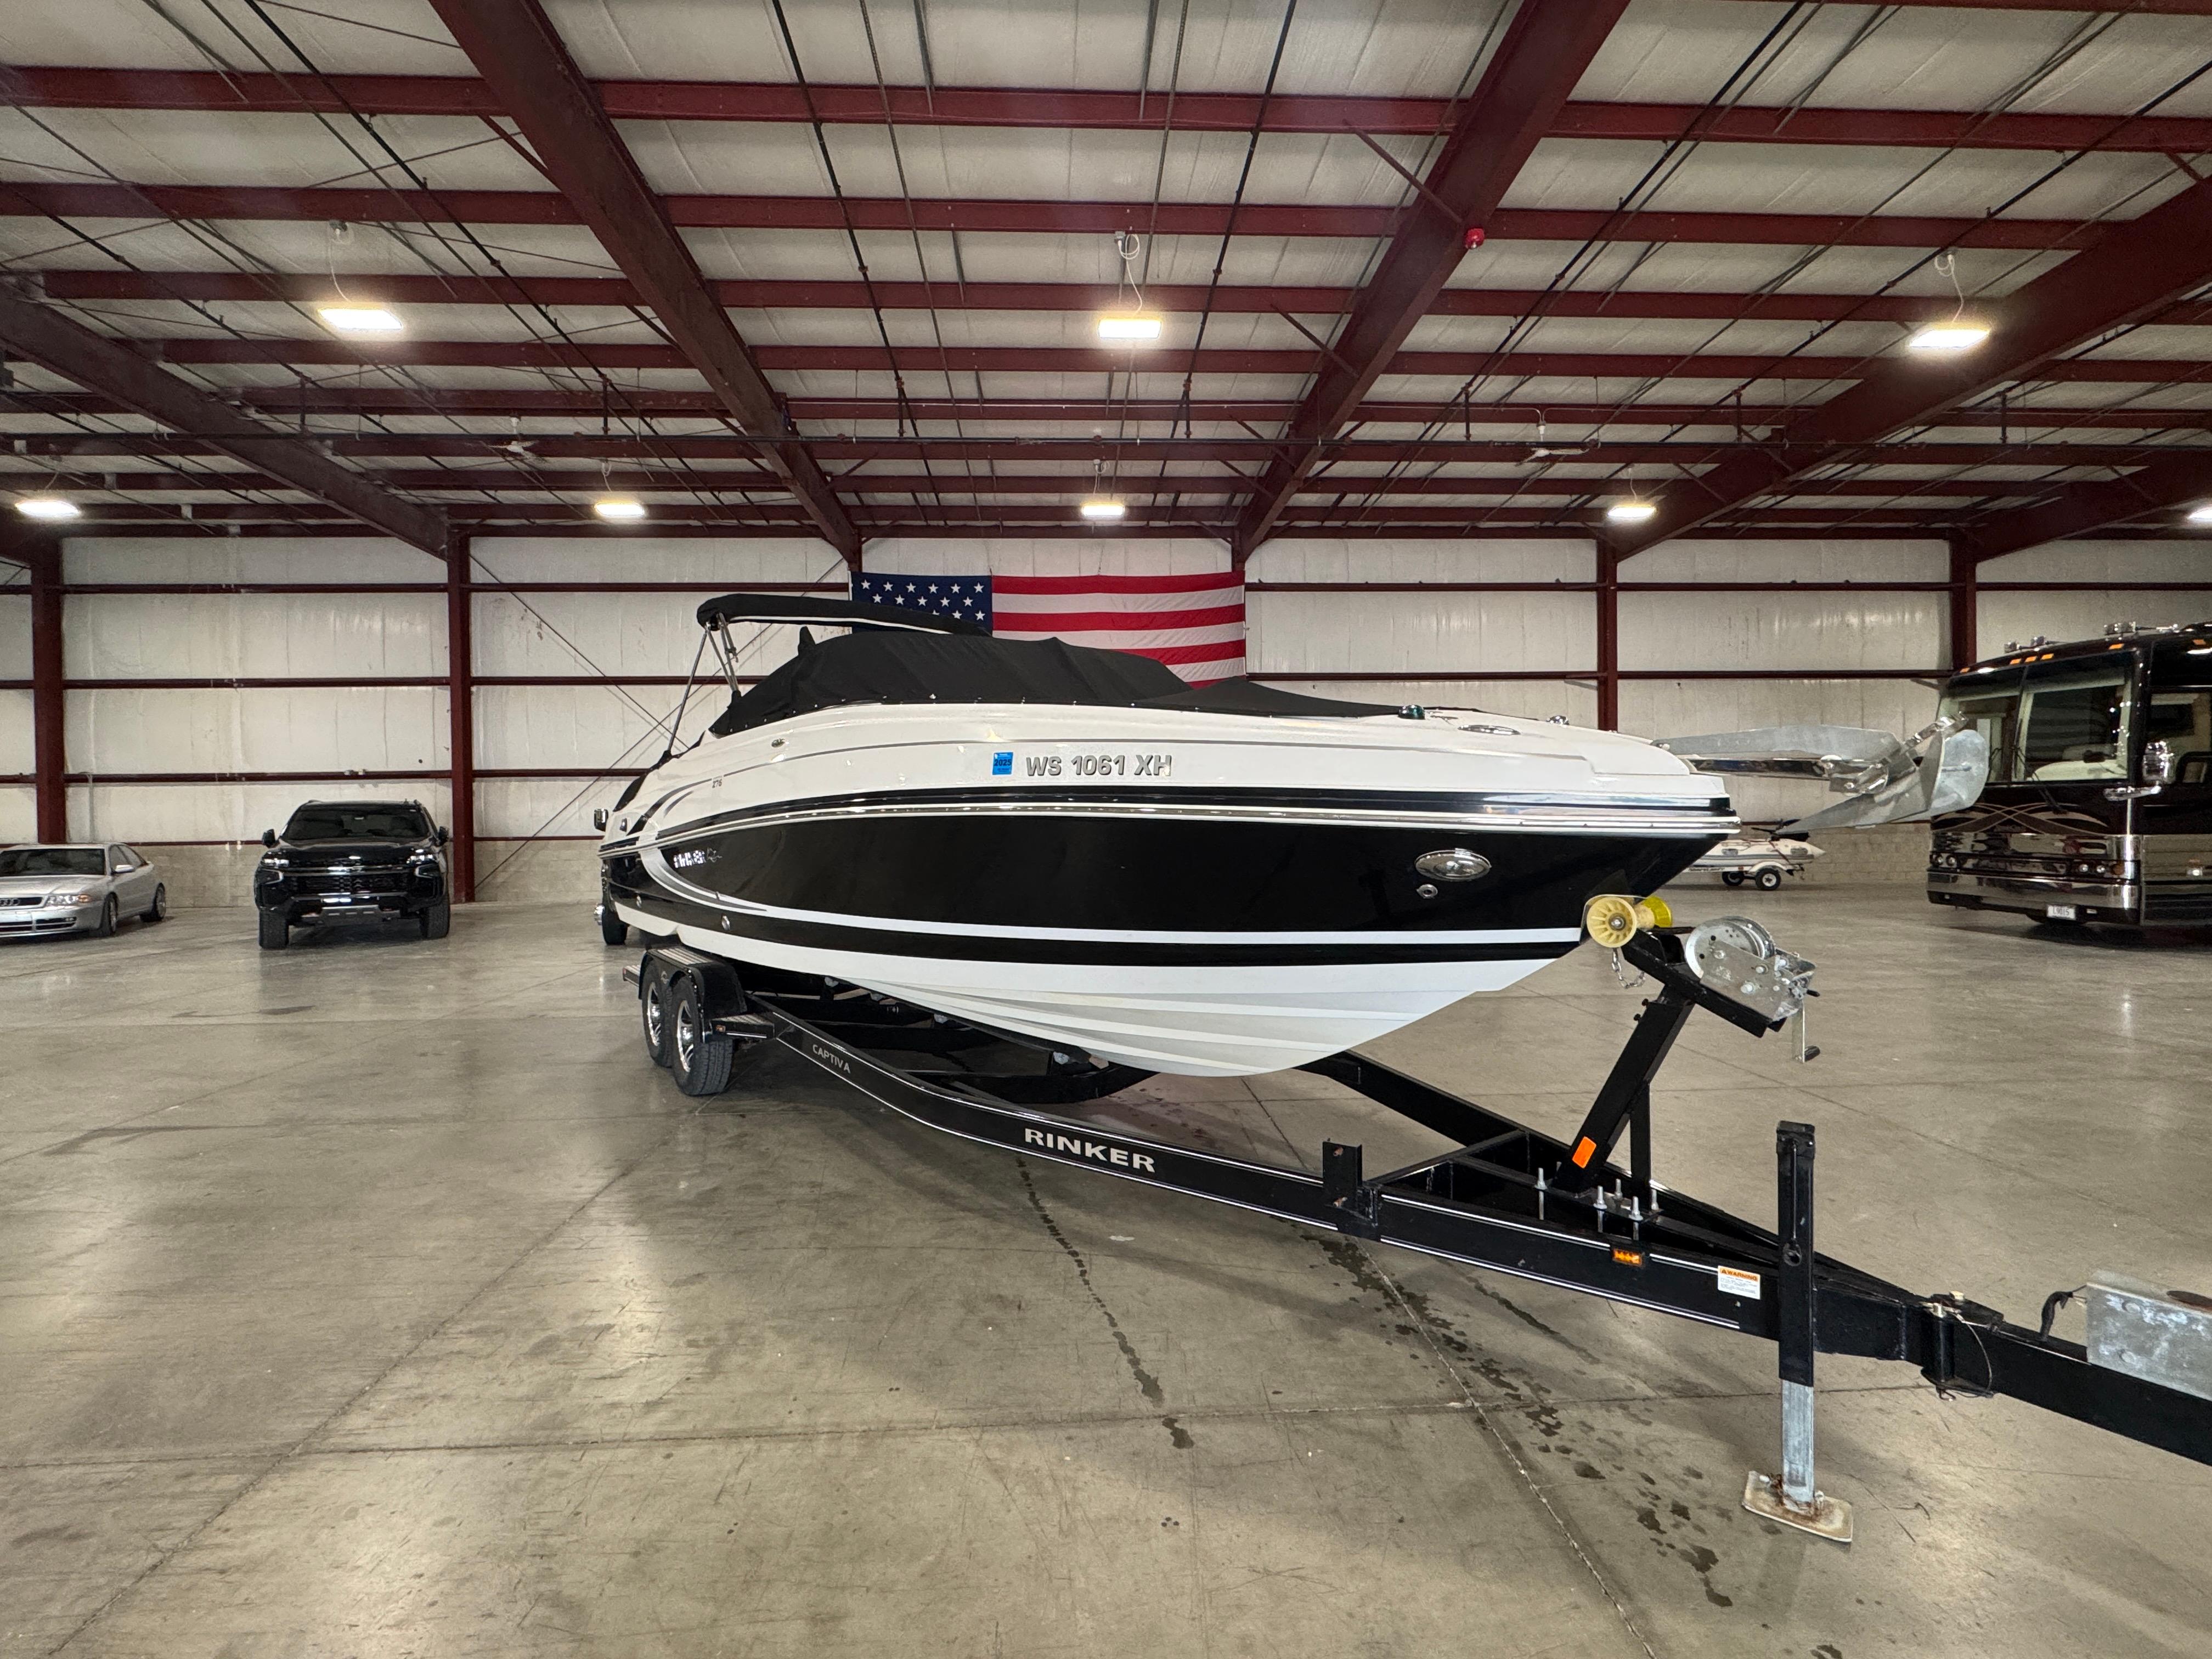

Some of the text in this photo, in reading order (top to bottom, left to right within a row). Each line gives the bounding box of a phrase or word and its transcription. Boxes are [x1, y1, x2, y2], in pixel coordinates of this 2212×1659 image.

[1026, 754, 1172, 776] WS 1061 XH
[812, 1044, 851, 1074] CAPTIVA
[1025, 1128, 1155, 1173] RINKER
[1728, 1270, 1758, 1282] WARNING
